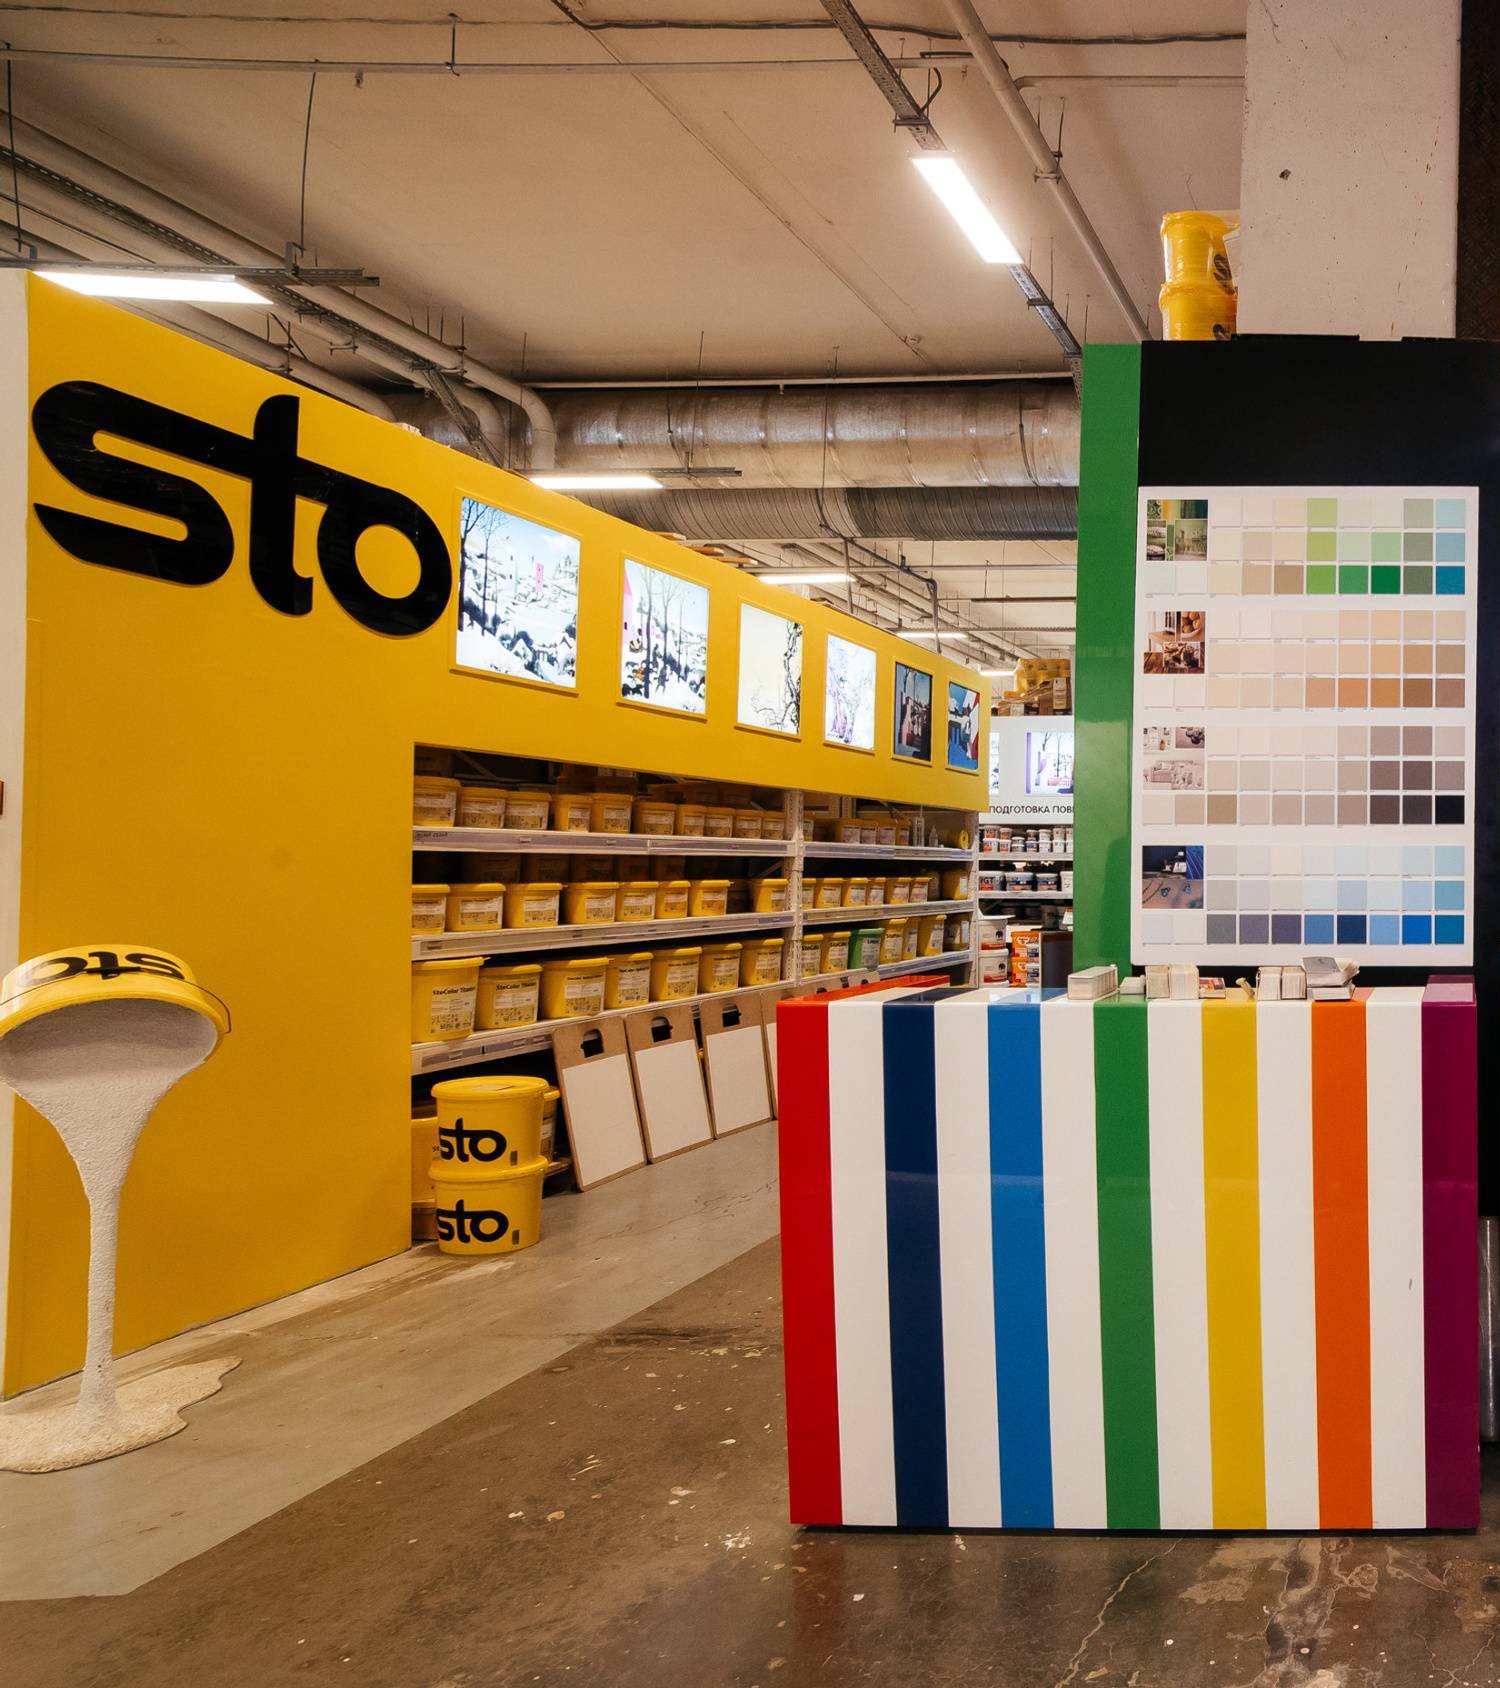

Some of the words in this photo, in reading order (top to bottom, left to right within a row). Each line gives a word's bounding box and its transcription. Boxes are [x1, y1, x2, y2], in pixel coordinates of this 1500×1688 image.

[32, 380, 453, 639] sto
[989, 805, 1050, 814] ПОДГОТОВКА
[1052, 805, 1073, 814] ПОВ
[439, 1117, 507, 1163] sto
[436, 1199, 509, 1243] sto
